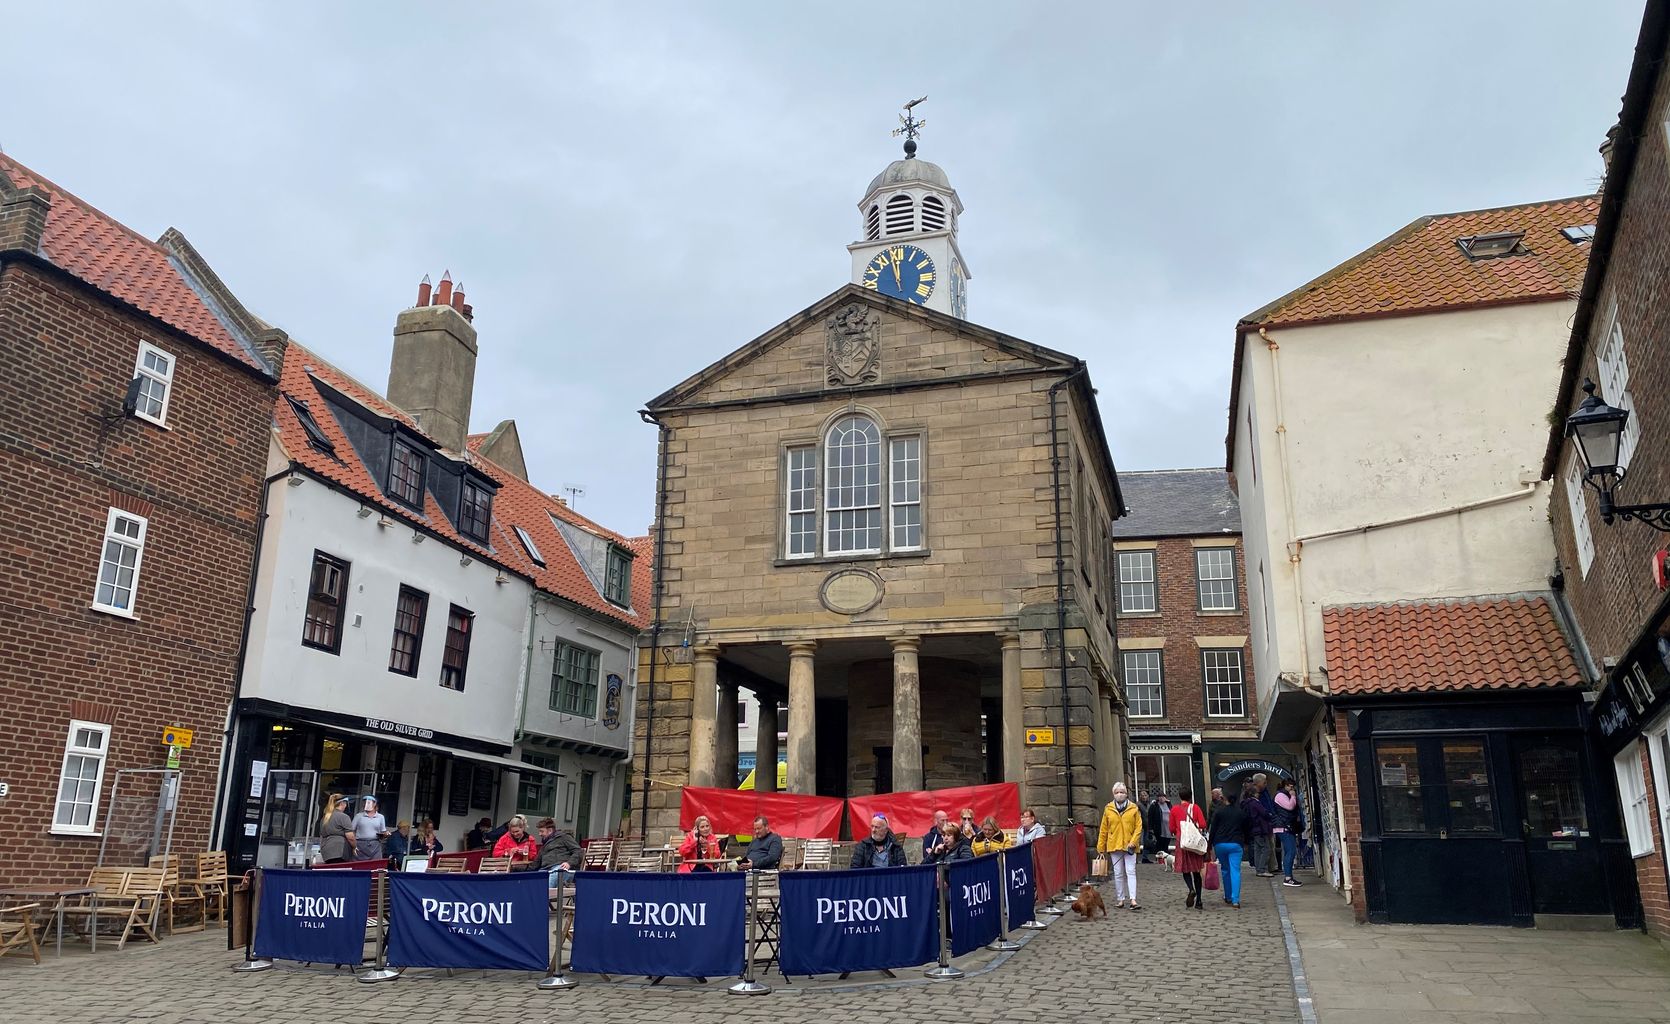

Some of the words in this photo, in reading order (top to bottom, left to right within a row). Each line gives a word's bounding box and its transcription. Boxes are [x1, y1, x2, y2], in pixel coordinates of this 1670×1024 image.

[366, 718, 380, 728] THE
[380, 720, 395, 731] OLD
[395, 723, 417, 736] SILVER
[417, 729, 433, 739] GRID
[1227, 761, 1261, 774] Sanders
[1263, 761, 1283, 776] Yard
[284, 892, 345, 918] PERONI
[421, 897, 513, 924] PERONI
[611, 898, 707, 926] PERONI
[816, 896, 908, 924] PERONI
[299, 920, 326, 929] ITALIA
[448, 926, 486, 936] ITALIA
[844, 925, 881, 935] ITALIA
[638, 930, 677, 939] ITALIA
